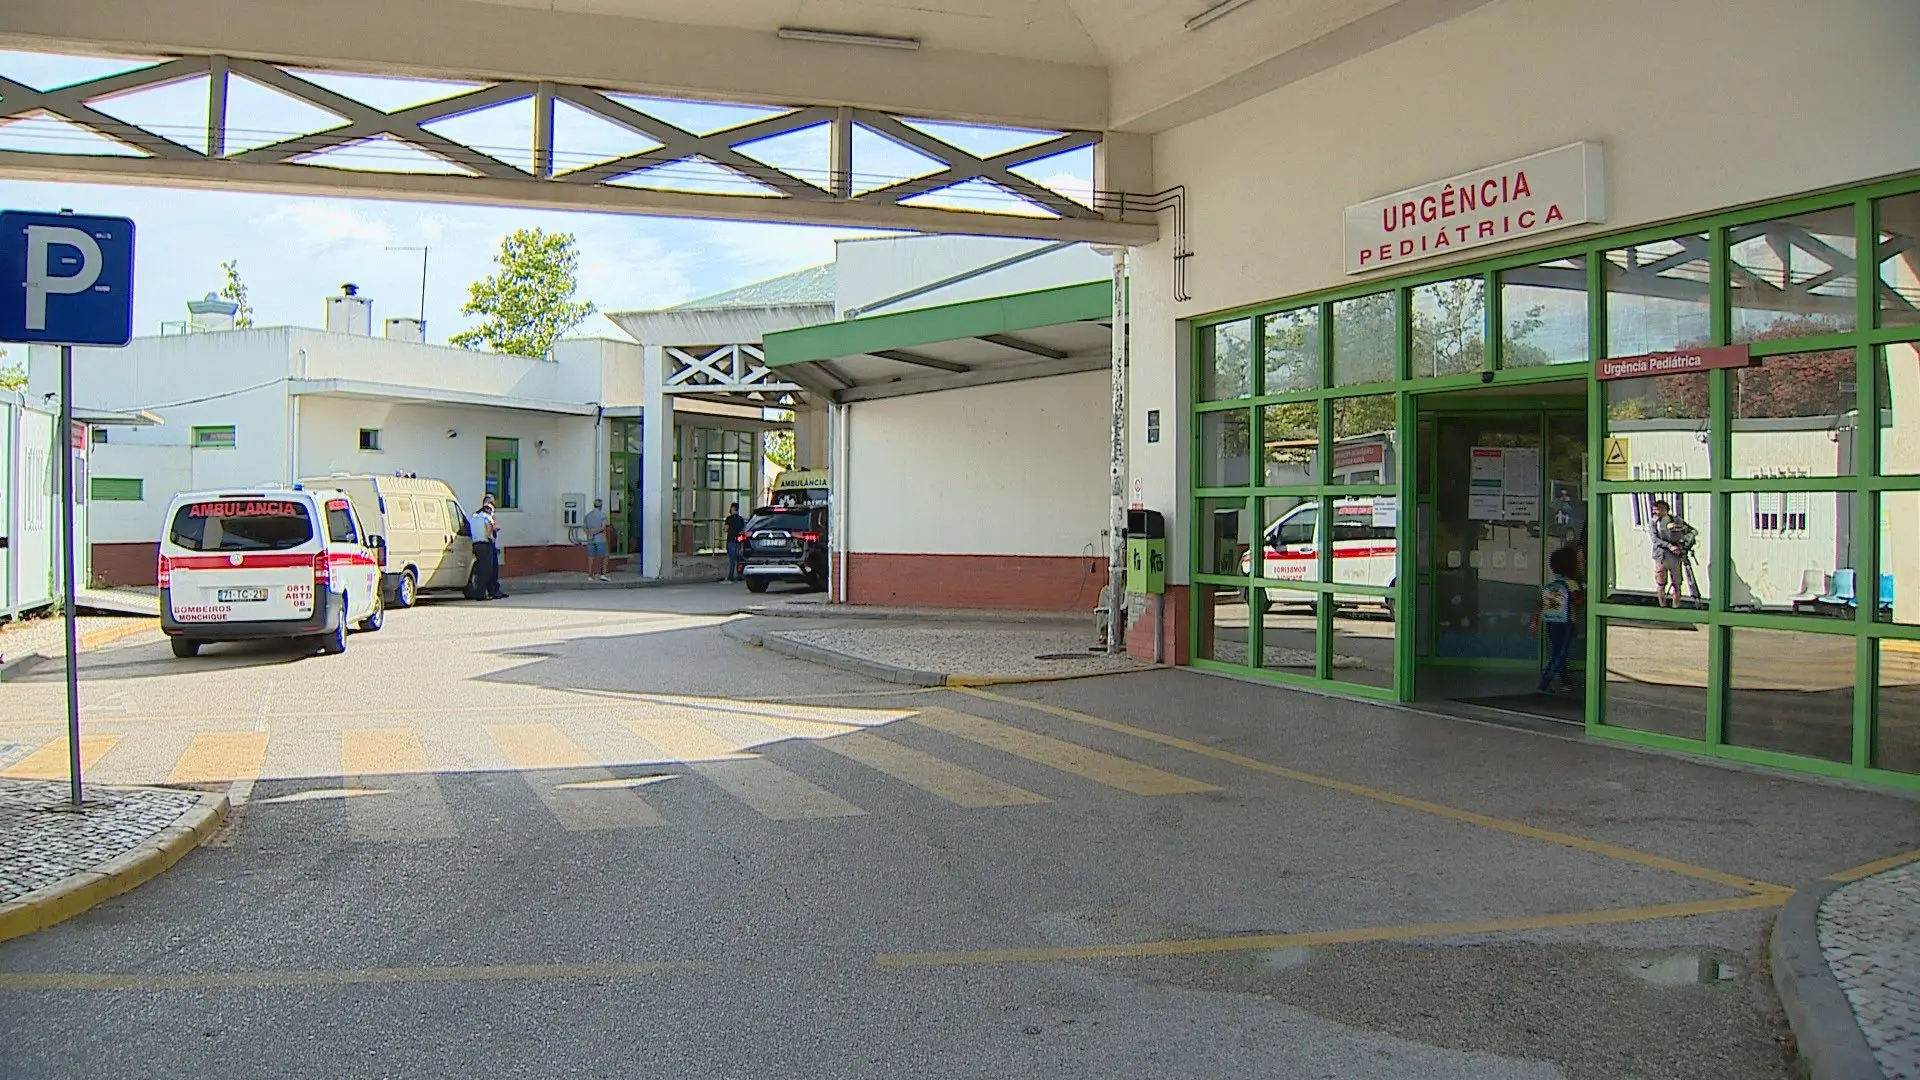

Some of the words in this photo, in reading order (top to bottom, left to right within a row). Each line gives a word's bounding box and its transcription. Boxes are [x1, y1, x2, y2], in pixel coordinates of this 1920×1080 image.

[1383, 171, 1531, 233] URGÊNCIA
[1359, 204, 1564, 265] PEDIÁTRICA
[25, 225, 103, 331] P
[1603, 360, 1648, 377] Urgência
[1649, 355, 1701, 371] Pediátrica
[285, 592, 313, 600] ABTD
[174, 605, 232, 614] BOMBEIROS
[178, 613, 228, 621] MONCHIQUE
